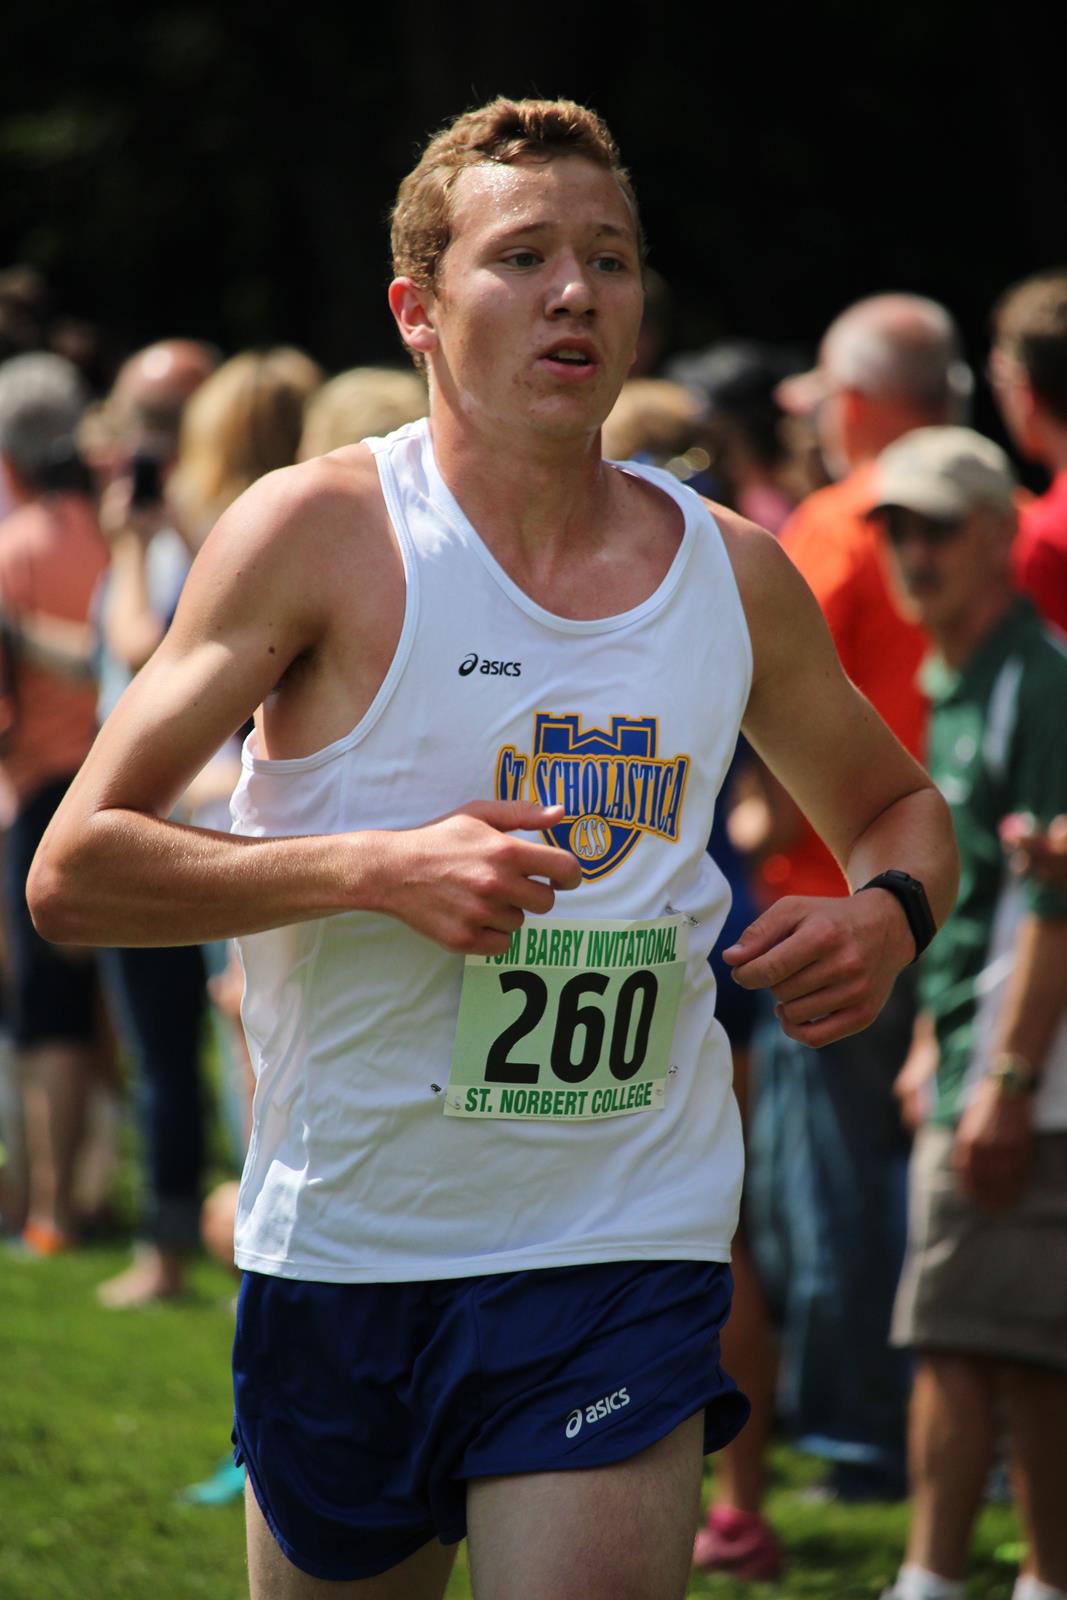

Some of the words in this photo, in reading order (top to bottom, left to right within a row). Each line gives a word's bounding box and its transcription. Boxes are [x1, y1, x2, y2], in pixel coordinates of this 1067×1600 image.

[536, 759, 687, 836] SCHOLASTICA
[573, 817, 606, 858] CSS
[525, 928, 584, 967] BARRY
[586, 926, 678, 968] INVITATIONAL
[484, 969, 659, 1085] 260
[465, 1087, 493, 1113] ST.
[499, 1088, 588, 1115] NORBERT
[591, 1082, 653, 1114] COLLEGE
